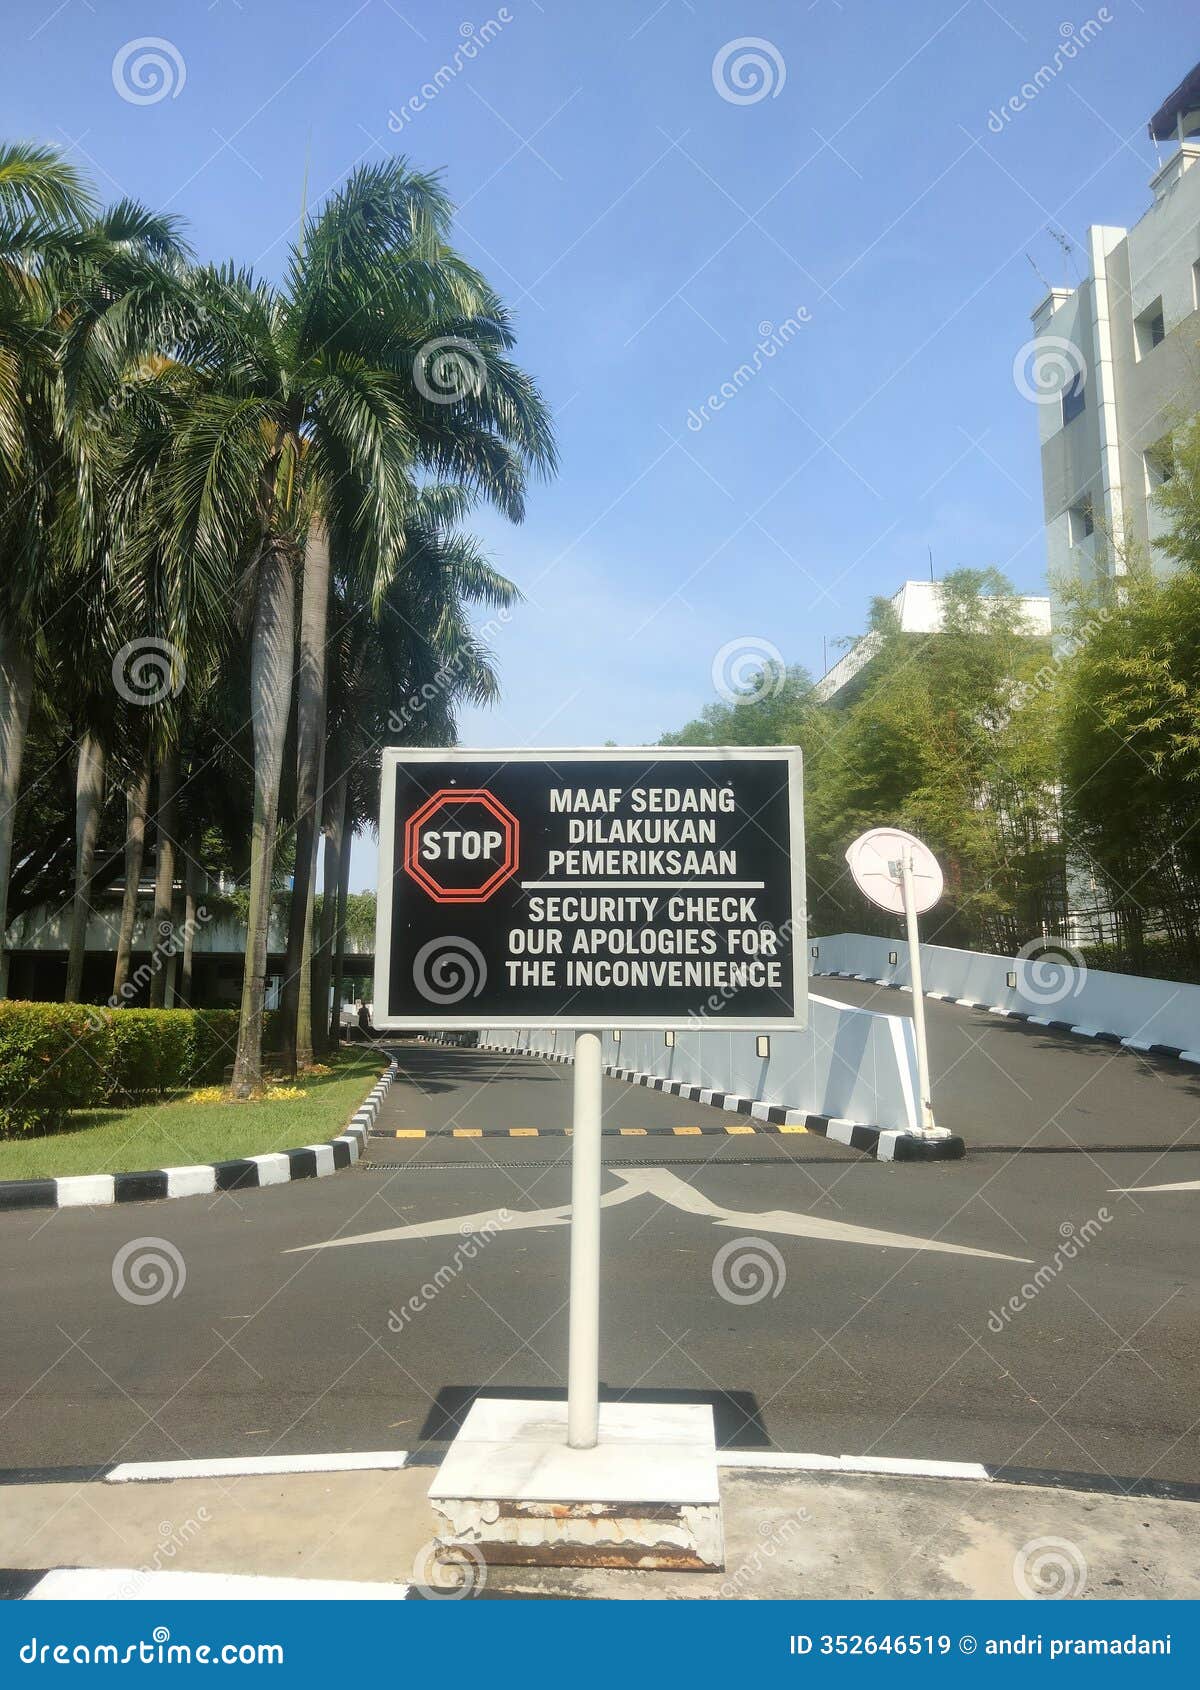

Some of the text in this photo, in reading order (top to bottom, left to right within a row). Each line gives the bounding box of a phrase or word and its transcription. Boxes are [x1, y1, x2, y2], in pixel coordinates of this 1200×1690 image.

[550, 788, 735, 813] MAAF SEDANG
[569, 818, 716, 844] DILAKUKAN
[422, 830, 503, 860] STOP
[548, 849, 737, 875] PEMERIKSAAN
[528, 896, 758, 922] SECURITY CHECK
[508, 928, 778, 955] OUR APOLOGIES FOR
[505, 960, 782, 988] THE INCONVENIENCE
